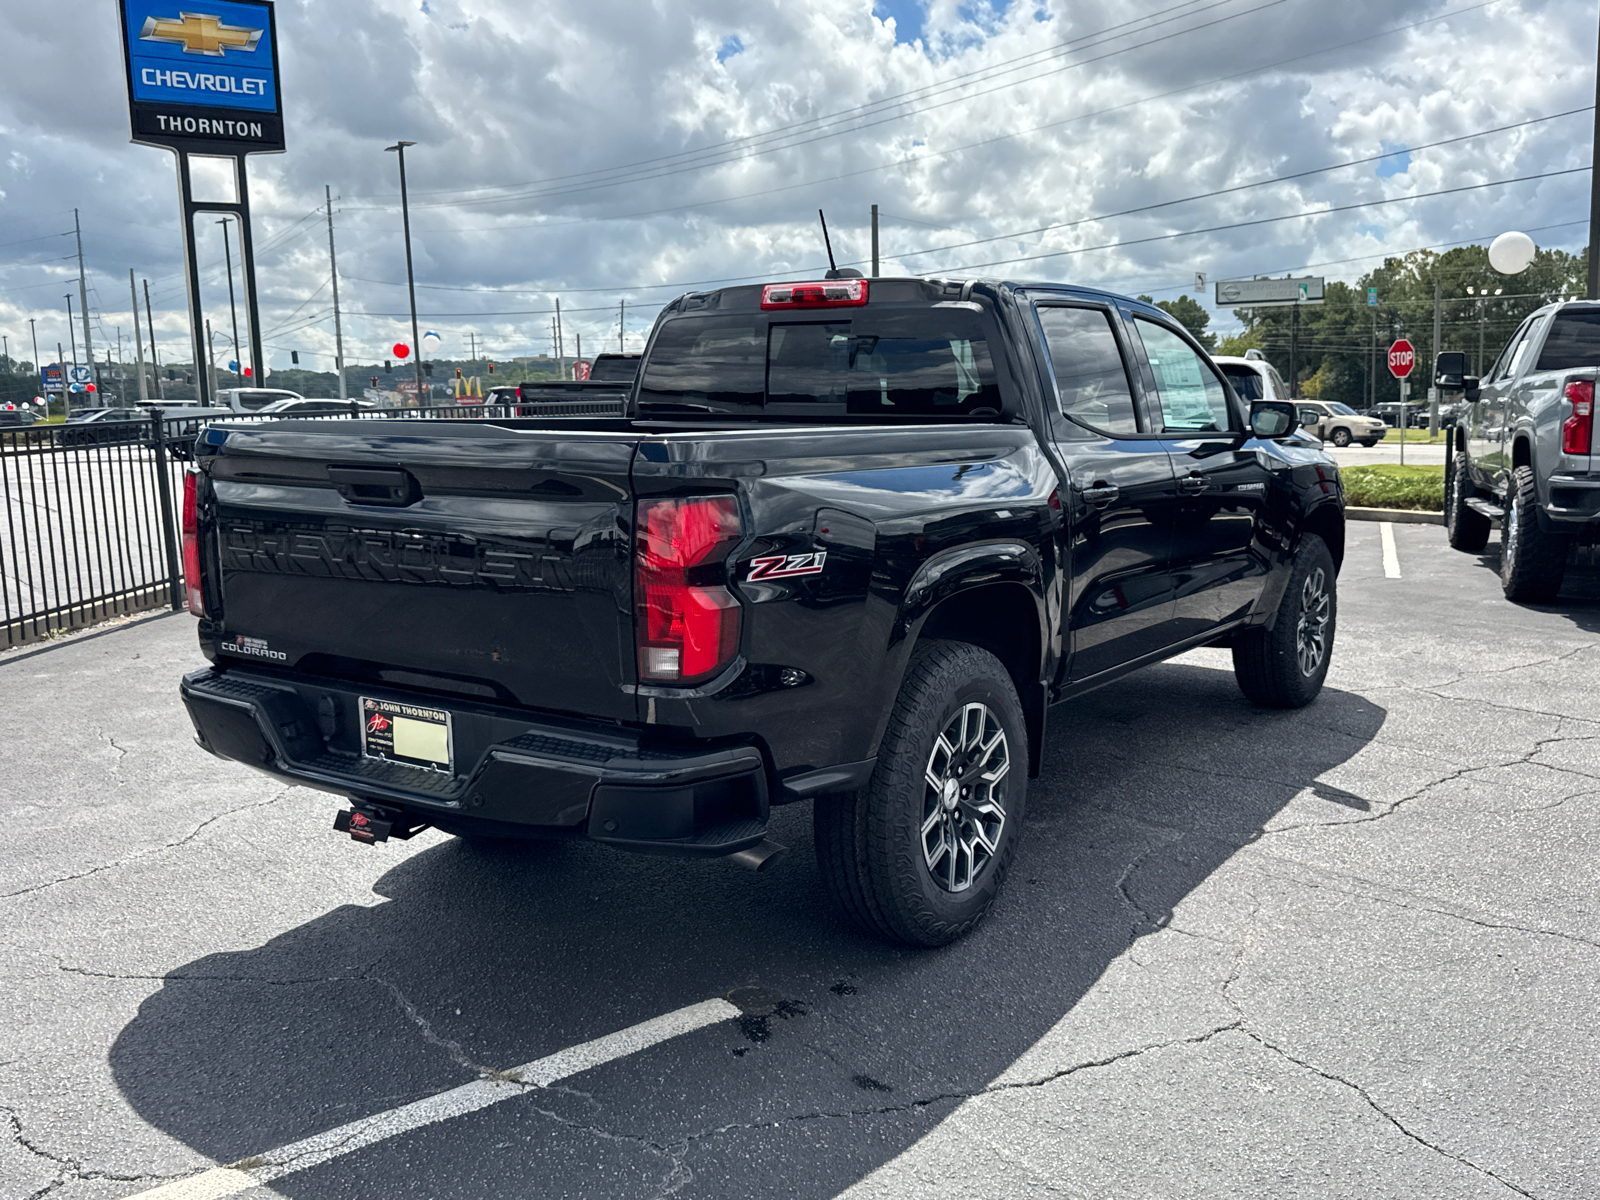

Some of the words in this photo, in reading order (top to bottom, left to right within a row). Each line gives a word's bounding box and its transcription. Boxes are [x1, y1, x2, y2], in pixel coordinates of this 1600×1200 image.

[141, 68, 268, 96] CHEVROLET
[156, 115, 263, 138] THORNTON
[1389, 351, 1413, 366] STOP
[226, 525, 572, 584] CHEVROLET
[746, 551, 828, 583] Z71
[221, 641, 287, 660] COLORADO
[379, 702, 400, 713] JOHN
[401, 706, 445, 721] THORNTON
